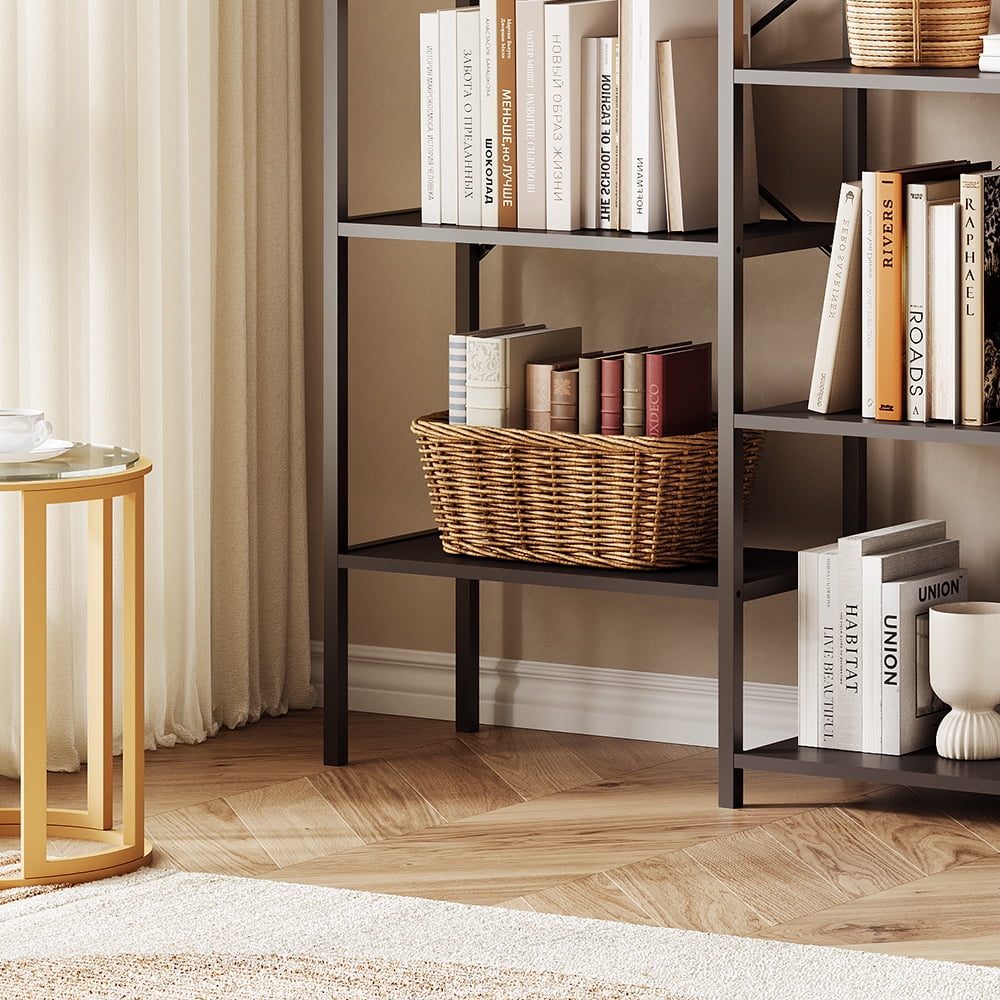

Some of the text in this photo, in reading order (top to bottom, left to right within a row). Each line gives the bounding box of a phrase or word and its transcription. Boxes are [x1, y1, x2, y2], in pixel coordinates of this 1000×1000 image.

[463, 50, 474, 199] ЗАБОТА О ПРЕДАННЫХ
[552, 34, 564, 202] НОВЫЙ ОБРАЗ ЖИЗНИ
[485, 138, 494, 205] ШОКОЛАД
[502, 163, 512, 207] ЛУЧШЕ
[883, 199, 894, 268] RIVERS
[964, 198, 976, 316] RAPHAEL
[910, 311, 924, 396] ROADS
[824, 626, 834, 742] LIVE BEAUTIFUL
[846, 604, 858, 694] HABITAT
[884, 615, 898, 686] UNION
